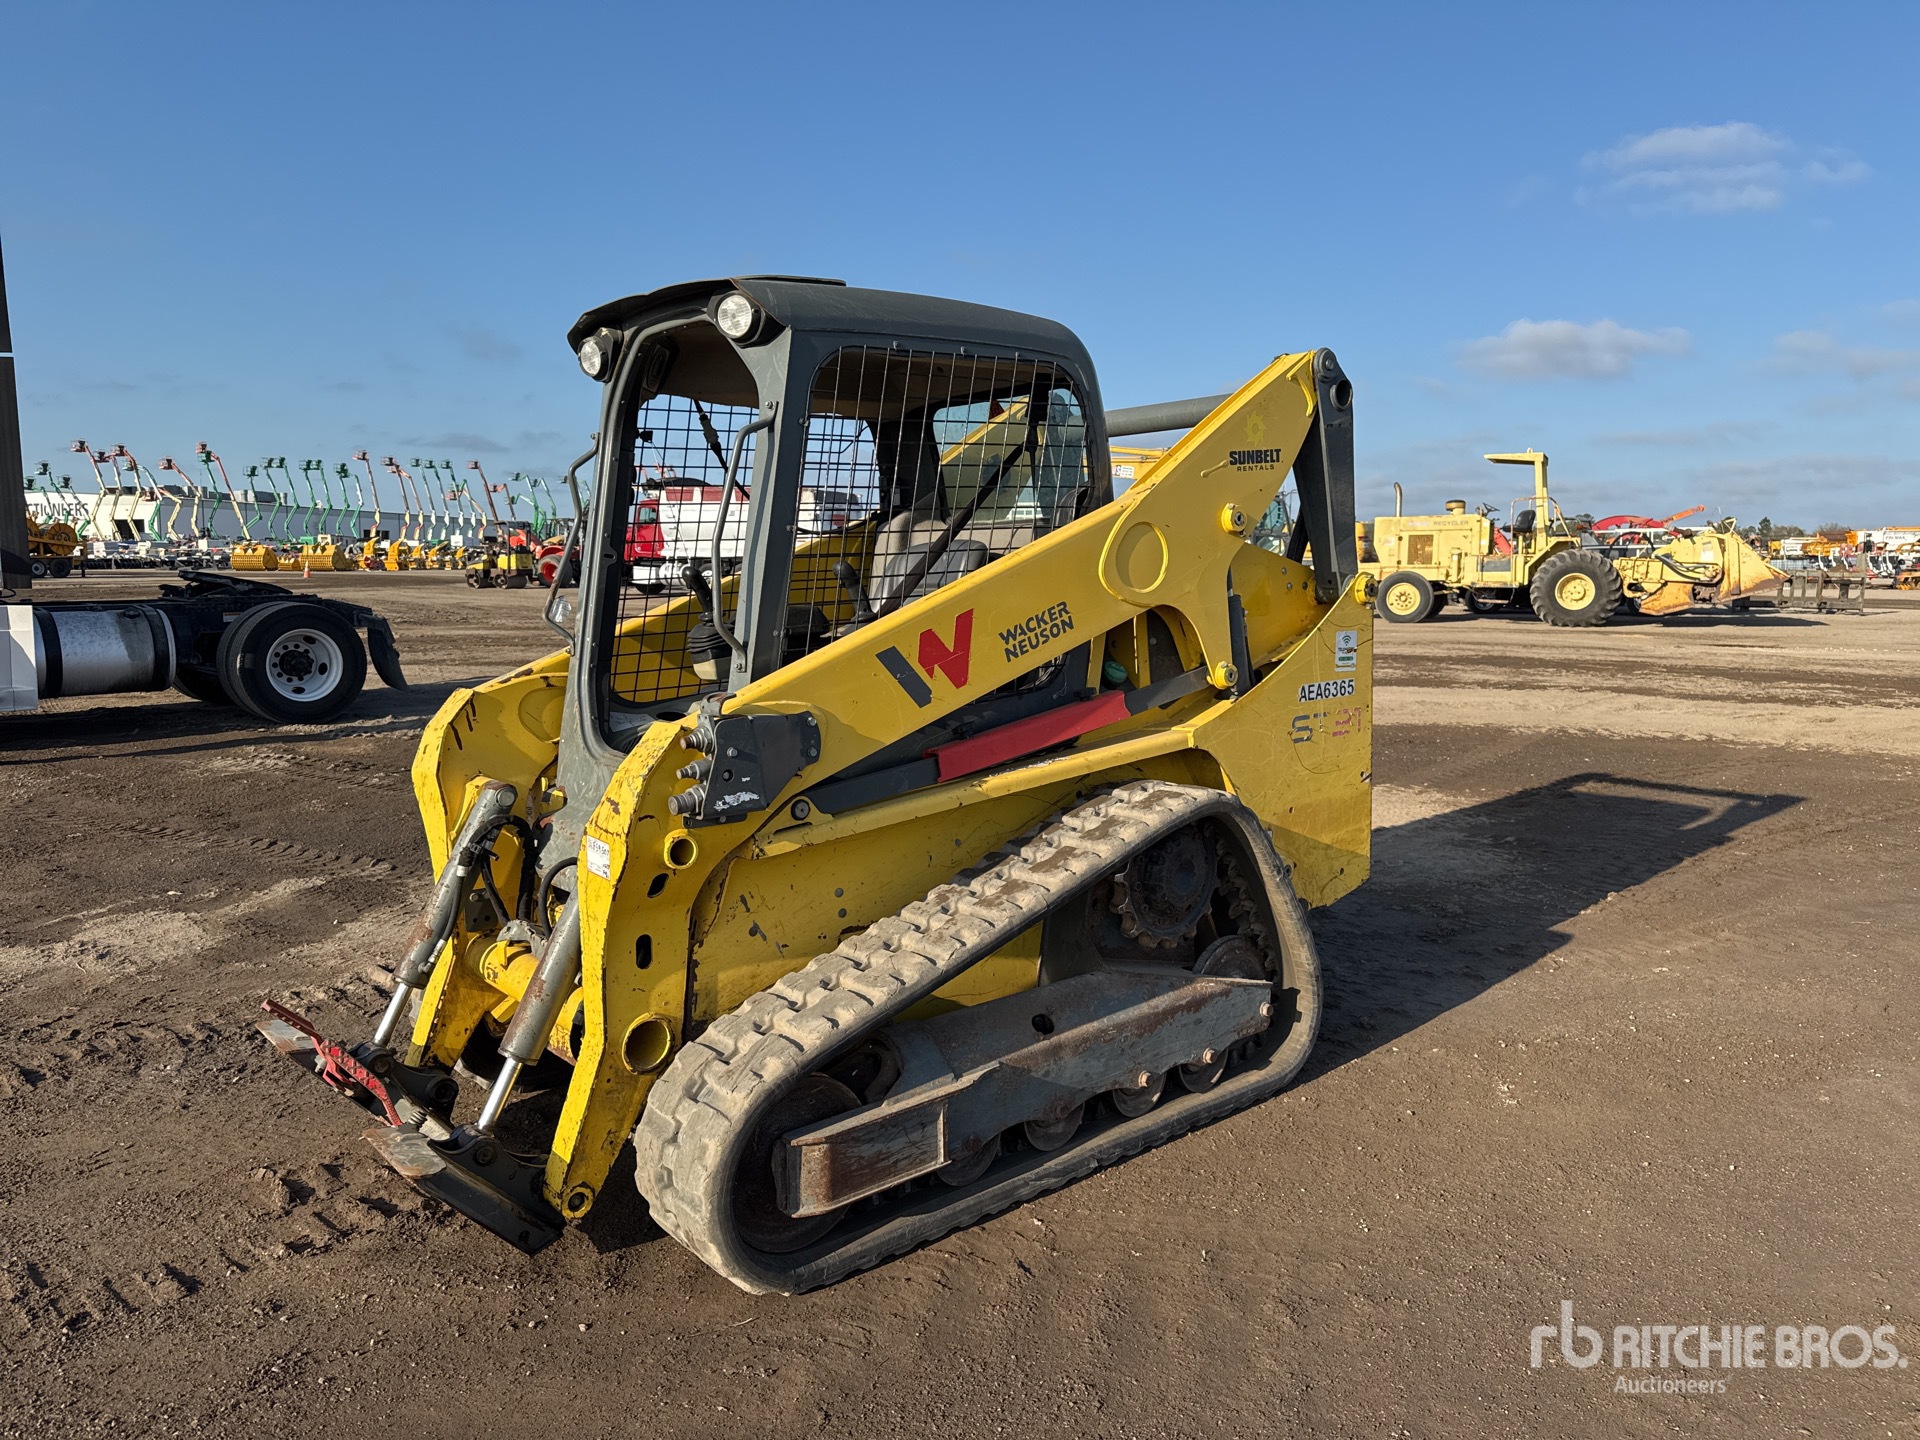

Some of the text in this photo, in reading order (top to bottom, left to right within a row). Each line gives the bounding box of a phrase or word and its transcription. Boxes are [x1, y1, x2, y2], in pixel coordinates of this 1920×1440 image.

[1229, 449, 1282, 465] SUNBELT
[1237, 464, 1275, 472] RENTALS
[998, 601, 1070, 645] WACKER
[1004, 616, 1074, 662] NEUSON
[1298, 679, 1354, 702] AEA6365
